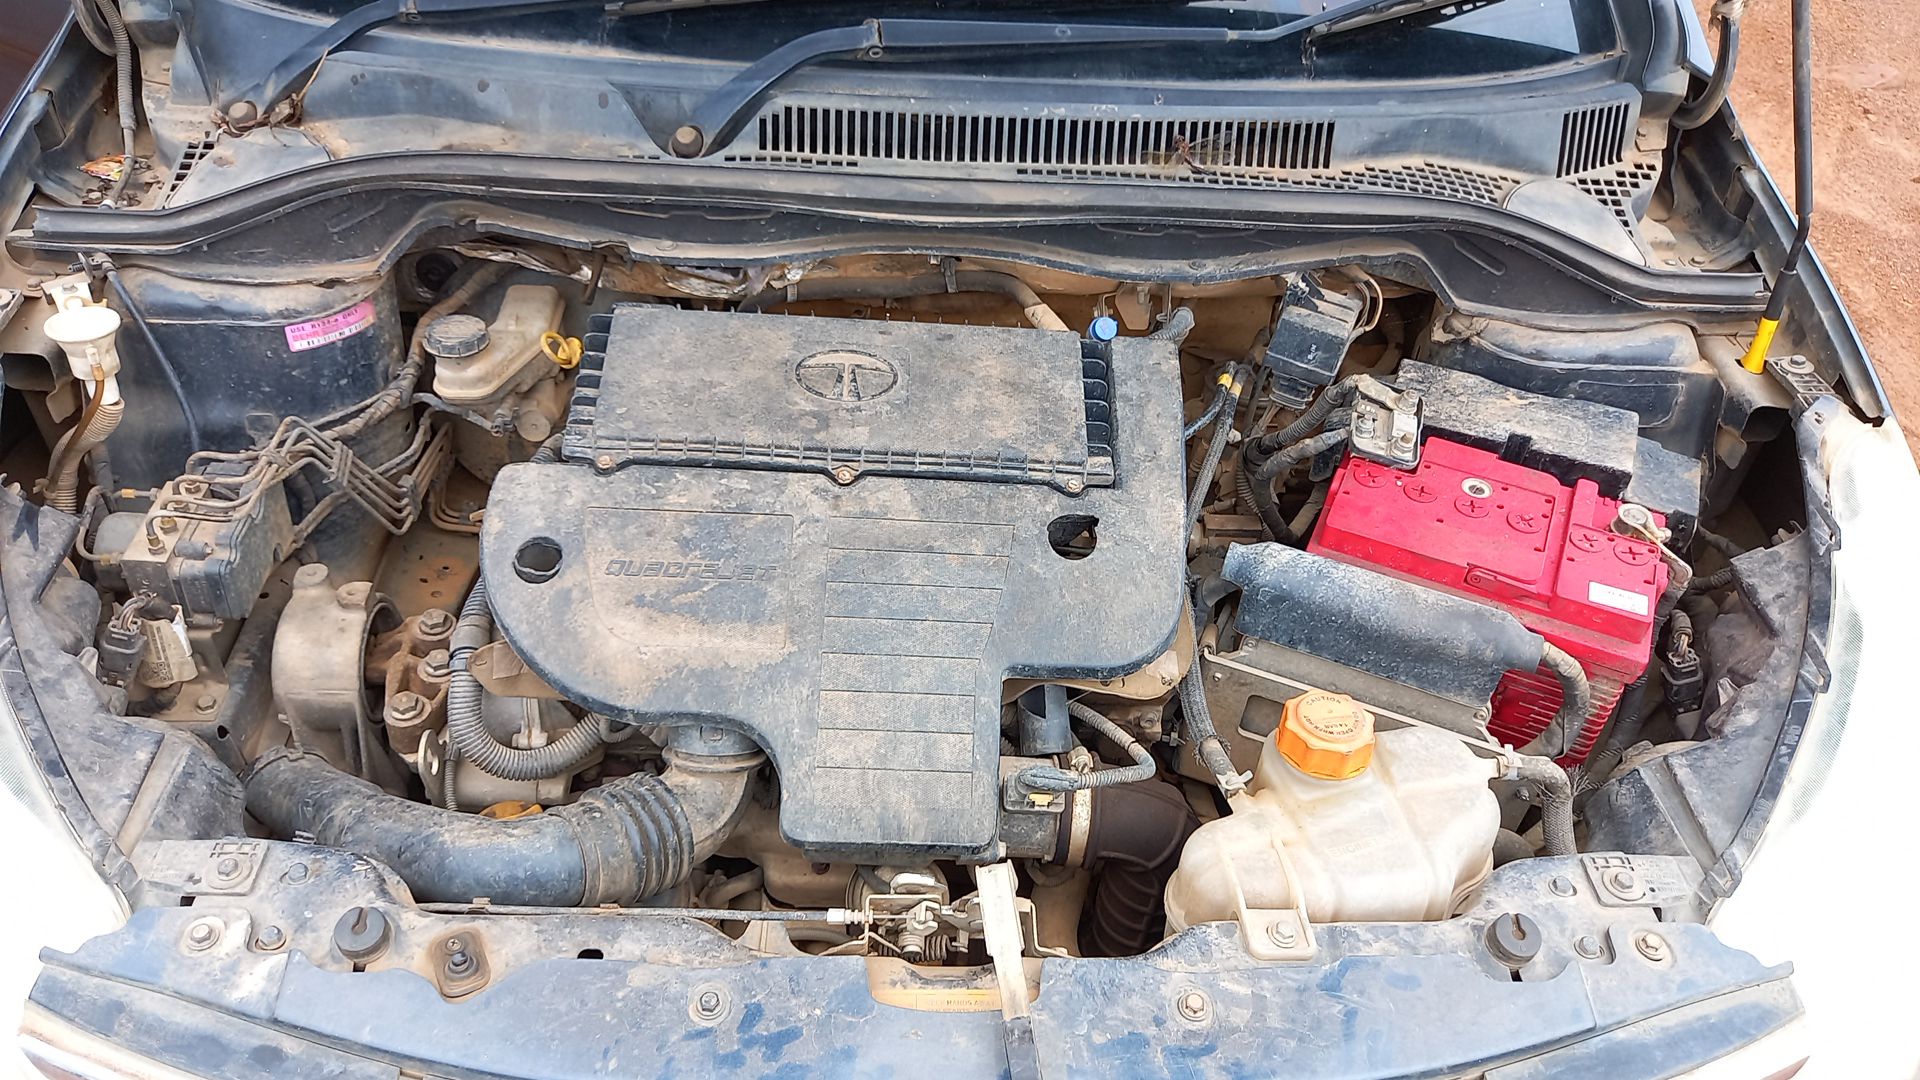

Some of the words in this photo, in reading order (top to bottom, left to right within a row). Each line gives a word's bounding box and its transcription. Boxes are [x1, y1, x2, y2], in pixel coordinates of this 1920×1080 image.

[290, 325, 306, 334] USE
[1306, 695, 1342, 706] CAUTION
[1303, 715, 1315, 726] HOT
[1313, 725, 1335, 736] WHEN
